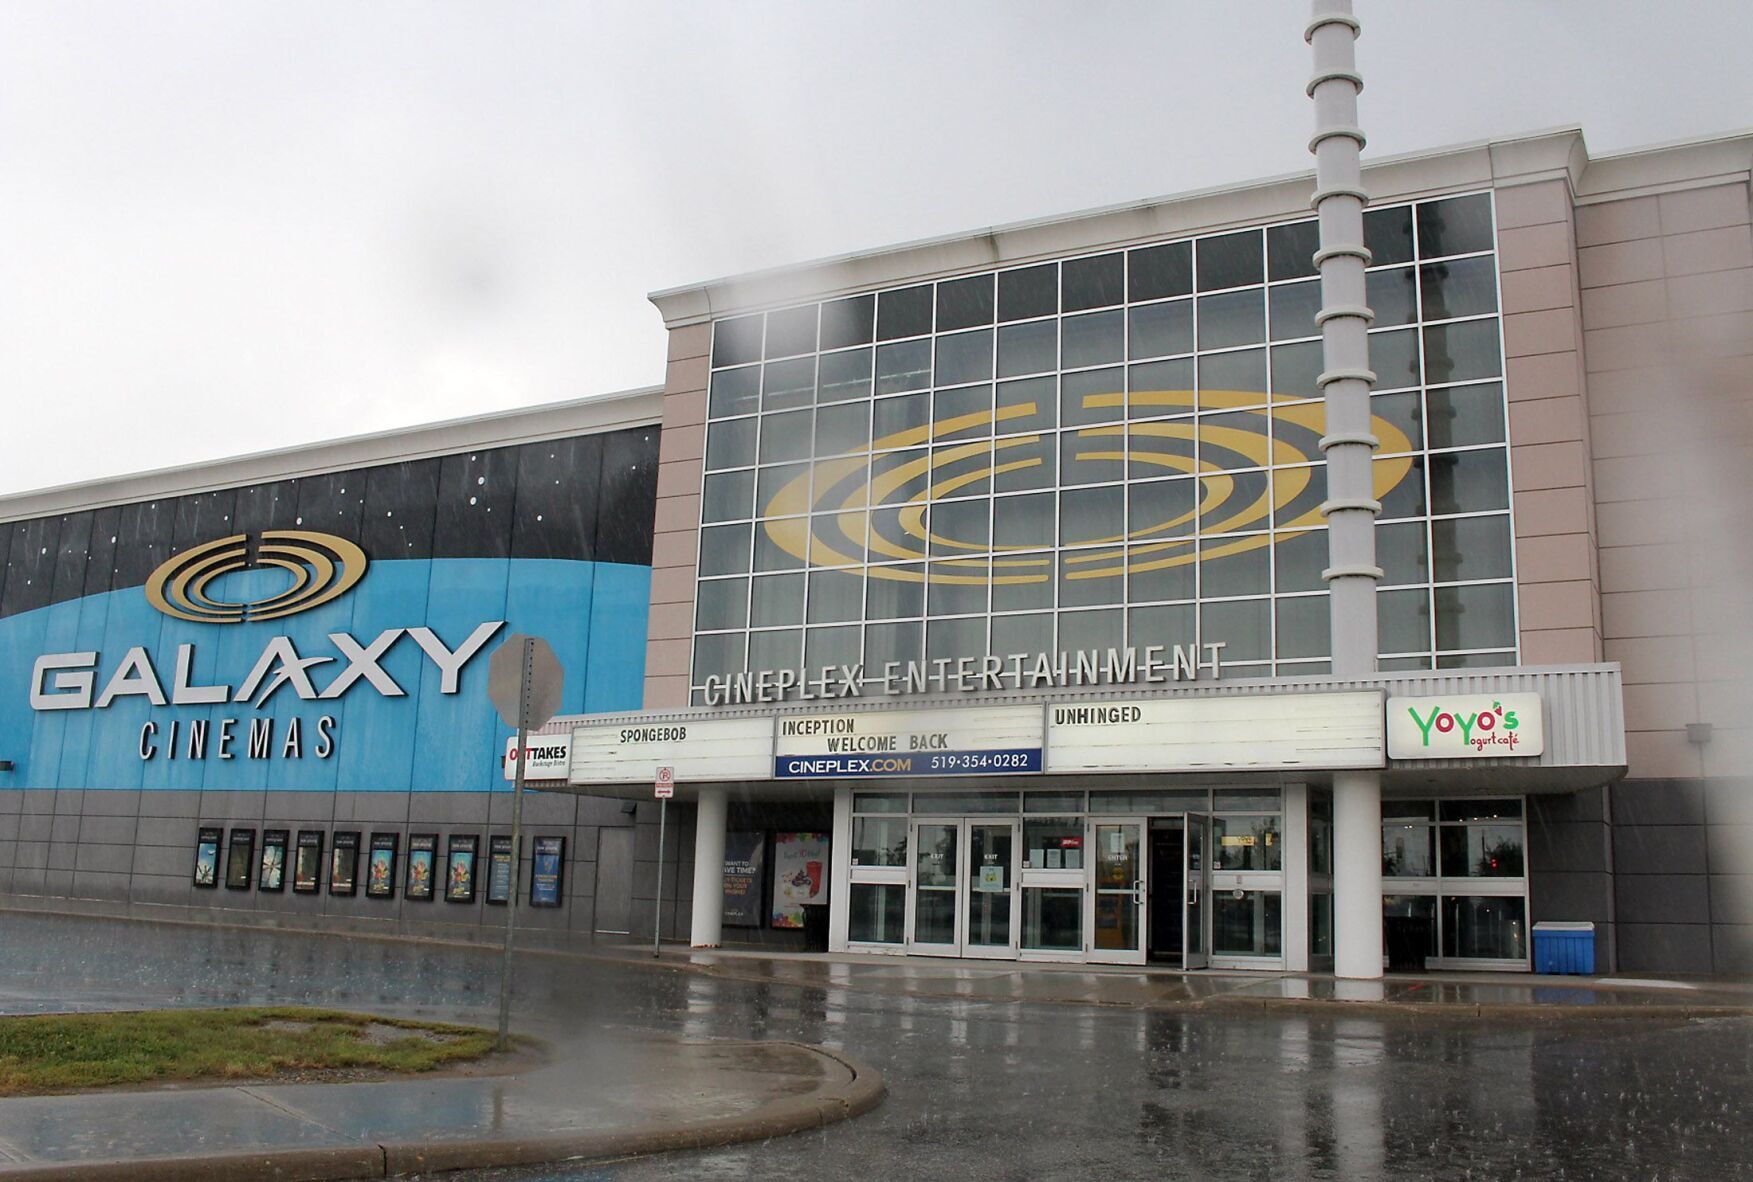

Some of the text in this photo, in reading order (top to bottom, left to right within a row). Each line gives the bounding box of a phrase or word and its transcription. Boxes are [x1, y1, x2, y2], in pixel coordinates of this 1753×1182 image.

[30, 621, 506, 710] GALAXY
[704, 641, 1228, 706] CINEPLEX ENTERTAINMENT
[1055, 706, 1141, 725] UNHINGED
[620, 726, 687, 743] SPONGEBOB
[782, 718, 855, 736] INCEPTION
[140, 716, 337, 760] CINEMAS
[827, 733, 948, 752] WELCOME BACK
[509, 746, 567, 761] OTTAKES
[788, 758, 911, 774] CINEPLEX.COM
